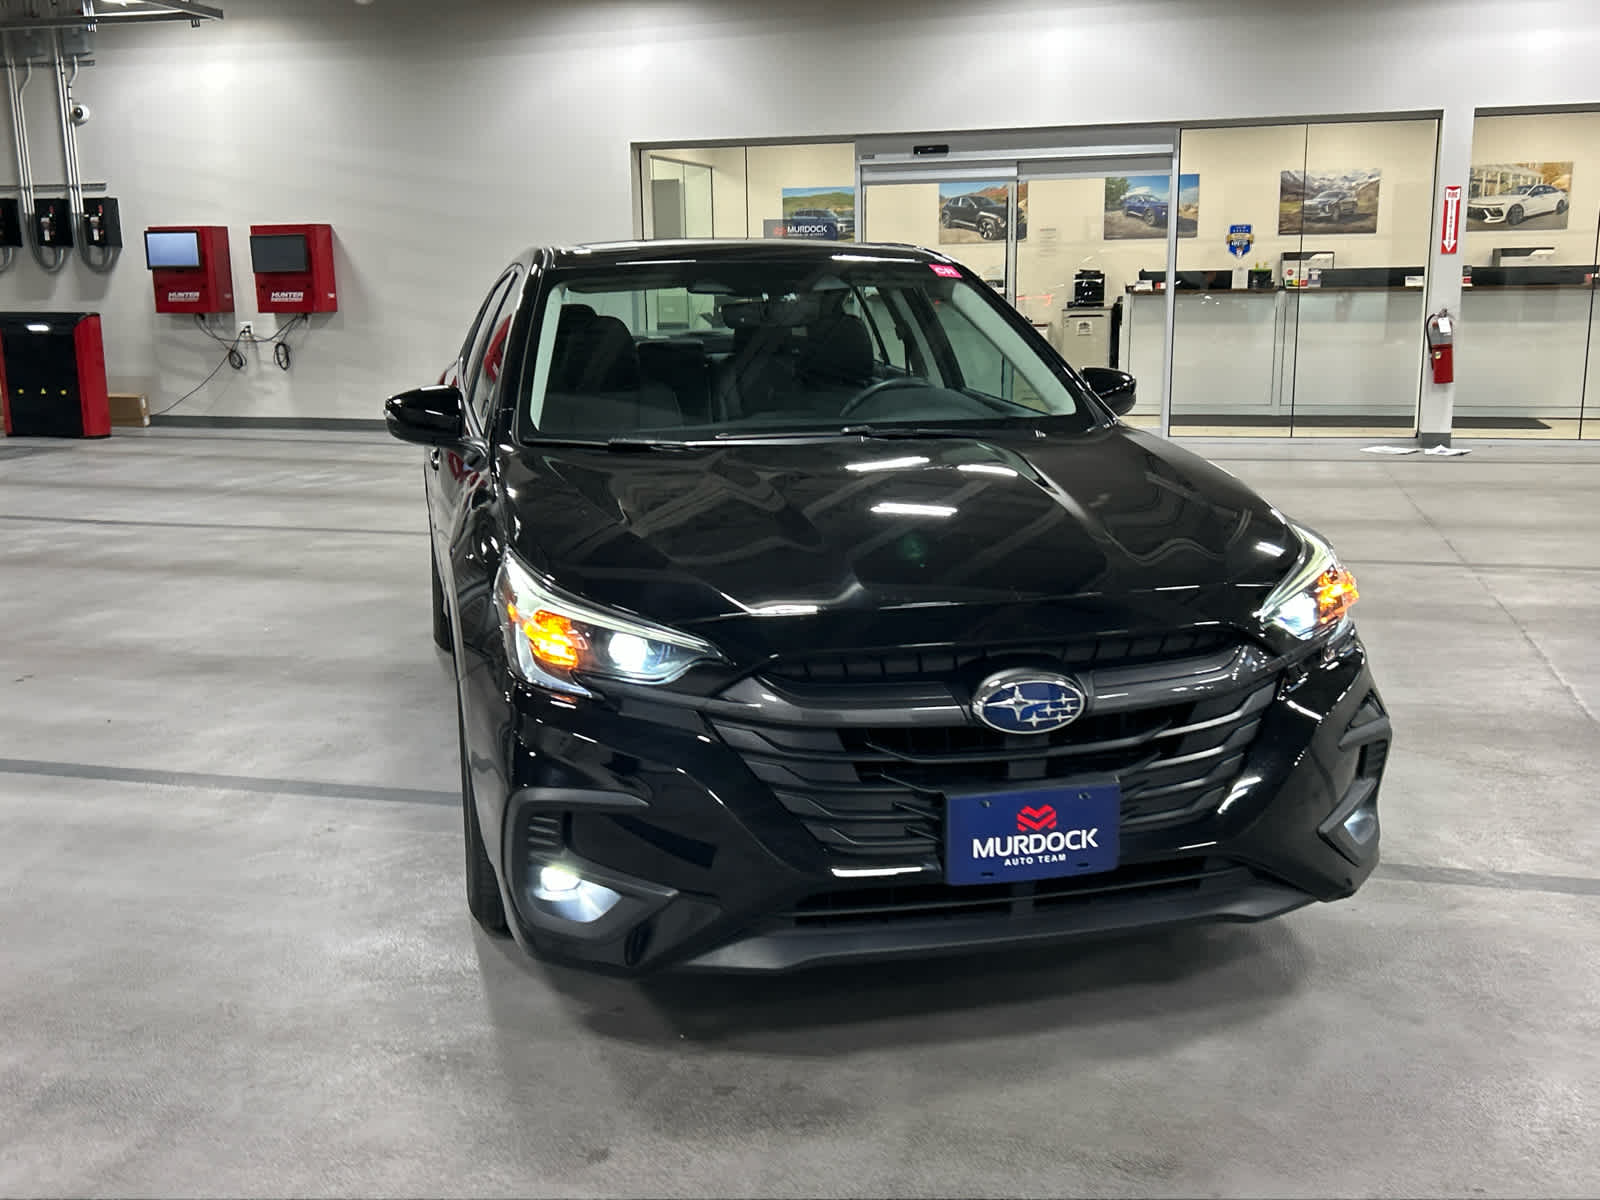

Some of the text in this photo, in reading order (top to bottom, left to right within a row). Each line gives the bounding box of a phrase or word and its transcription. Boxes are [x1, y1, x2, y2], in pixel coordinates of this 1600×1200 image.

[787, 225, 828, 233] MURDOCK
[973, 828, 1098, 858] MURDOCK
[1004, 853, 1066, 866] AUTO TEAM
